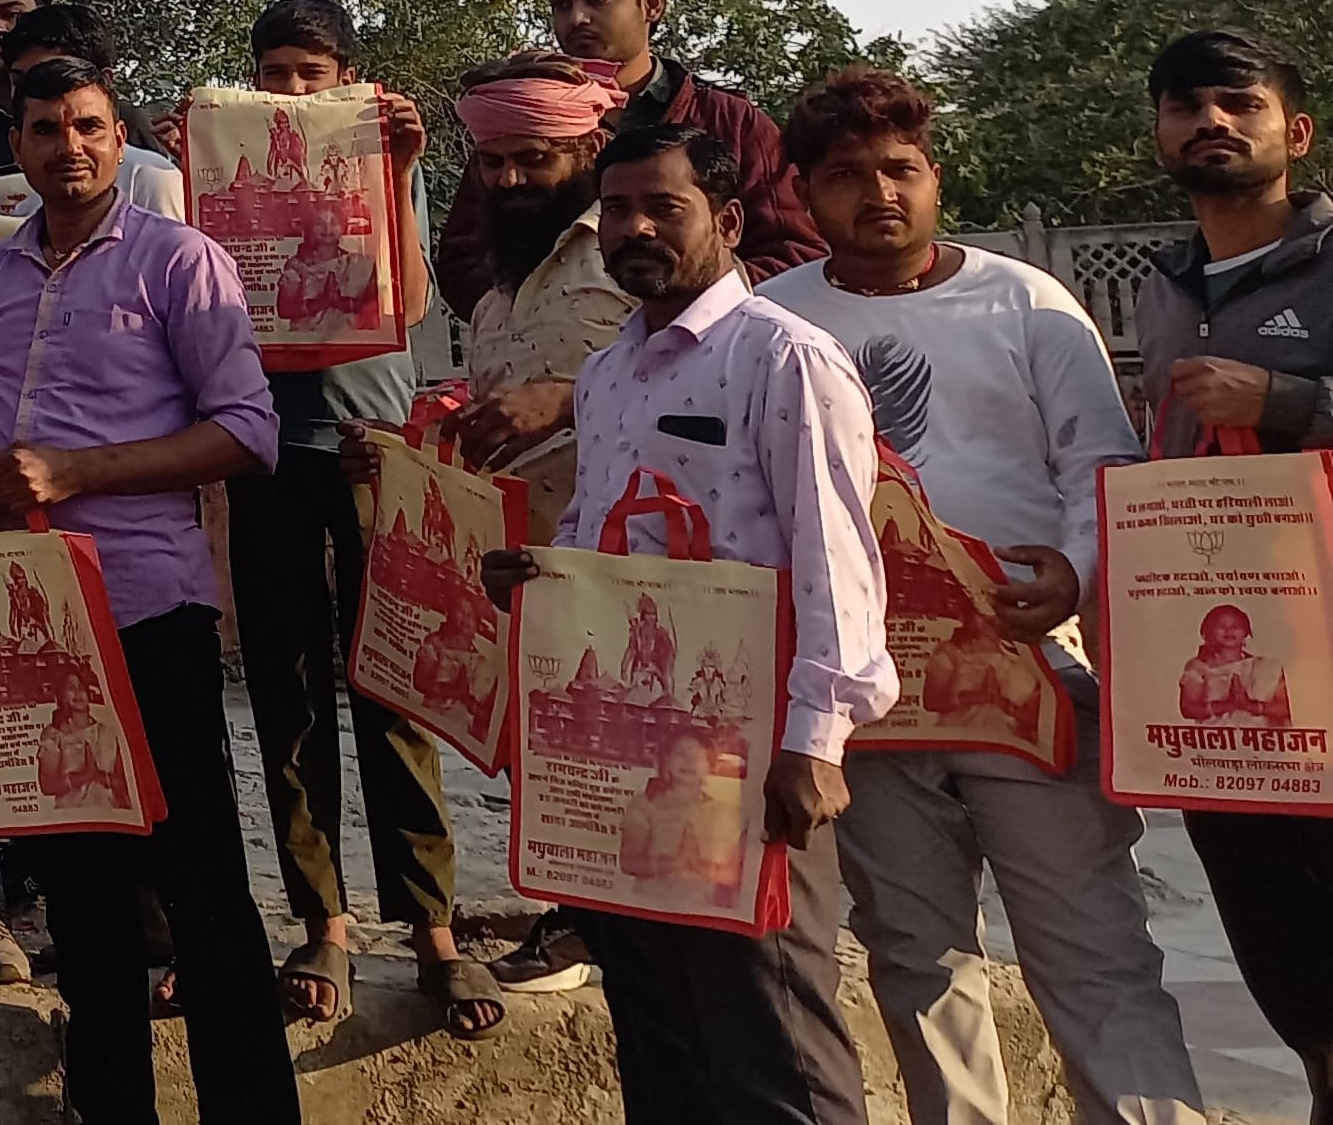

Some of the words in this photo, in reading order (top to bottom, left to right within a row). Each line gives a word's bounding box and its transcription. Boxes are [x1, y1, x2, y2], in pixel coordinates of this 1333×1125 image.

[1258, 325, 1309, 339] adidas
[1146, 724, 1236, 757] मधुबाला
[1240, 727, 1327, 753] महाजन
[1216, 776, 1265, 790] 82097
[1271, 778, 1321, 793] 04883
